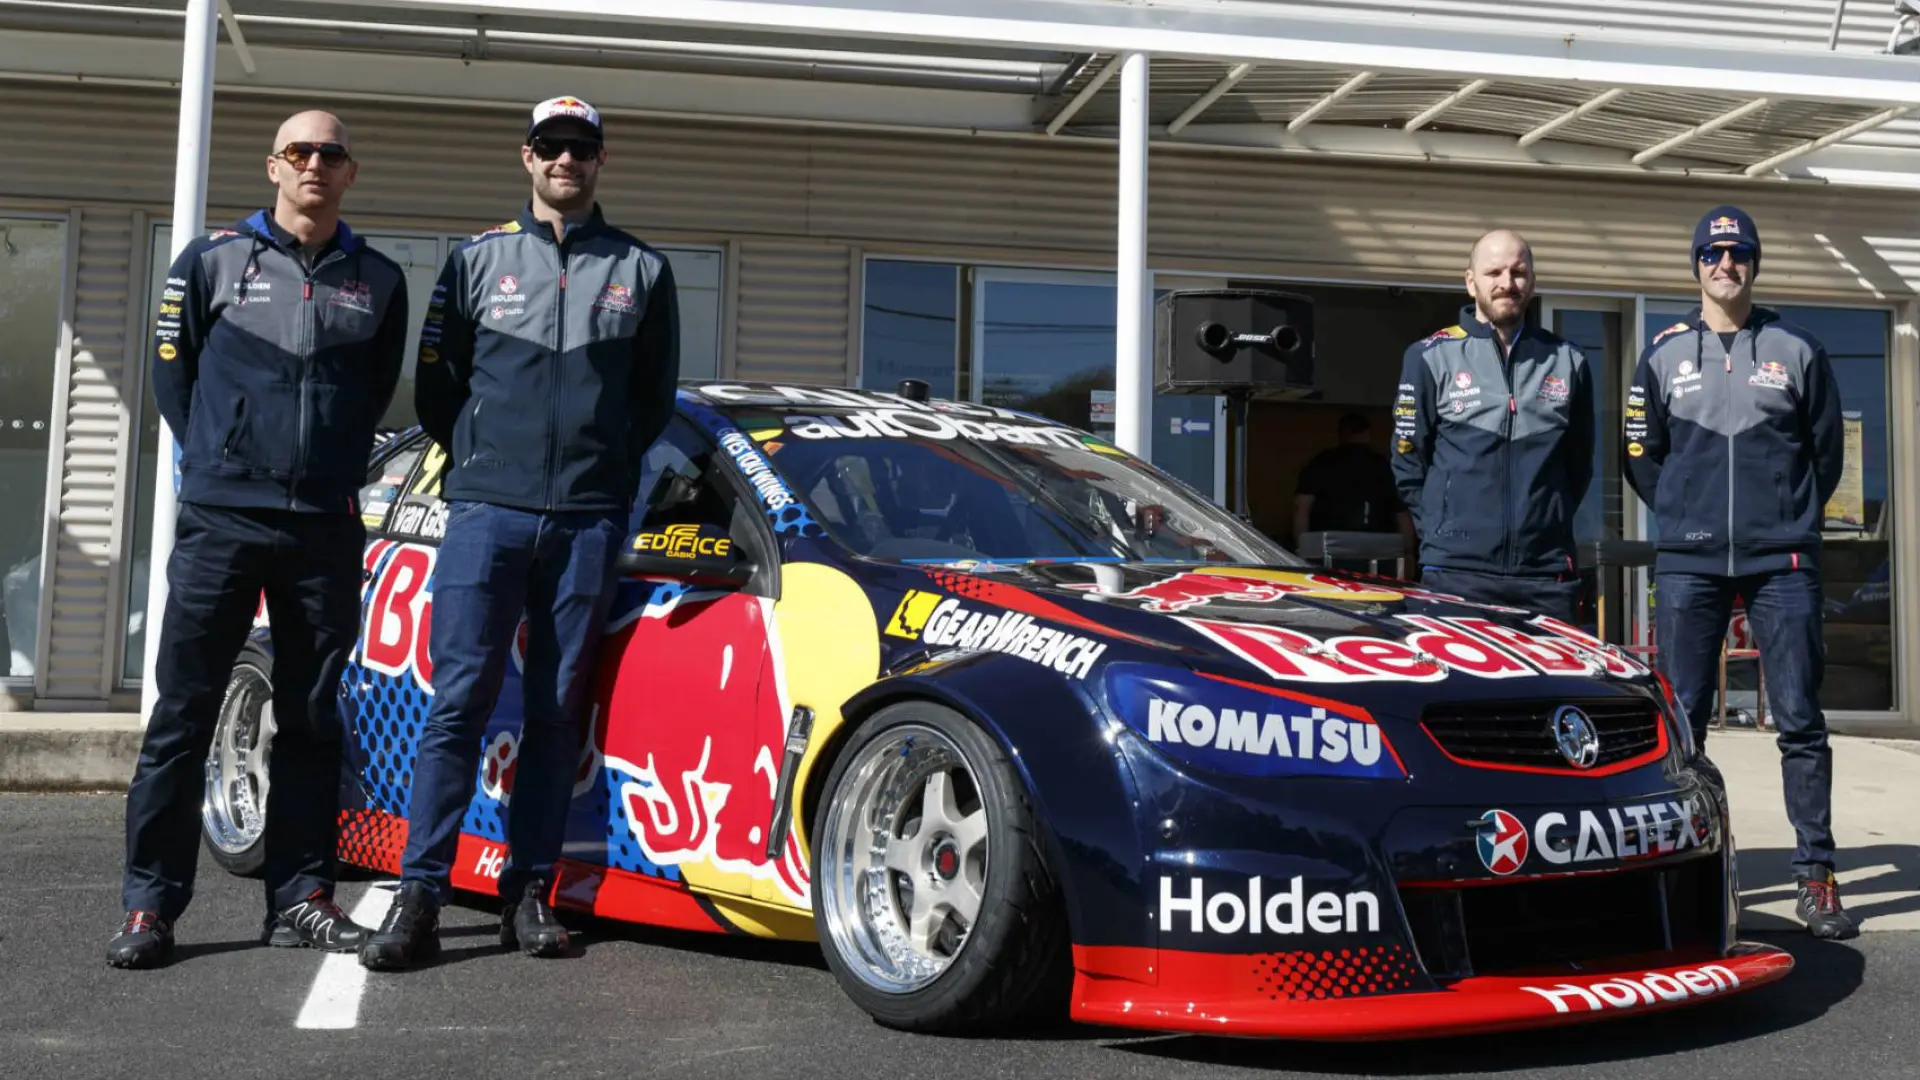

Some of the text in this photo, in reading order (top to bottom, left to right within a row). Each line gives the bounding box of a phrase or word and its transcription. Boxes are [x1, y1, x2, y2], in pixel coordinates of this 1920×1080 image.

[491, 294, 524, 302] HOLDEN
[736, 451, 771, 475] YOU
[750, 470, 795, 510] WINGS
[633, 533, 730, 556] EDIFICE
[666, 550, 696, 559] CASIO
[1148, 698, 1381, 766] KOMATSU
[1534, 800, 1700, 864] CALTEX
[1160, 875, 1380, 934] Holden
[1519, 964, 1741, 1013] Holden
